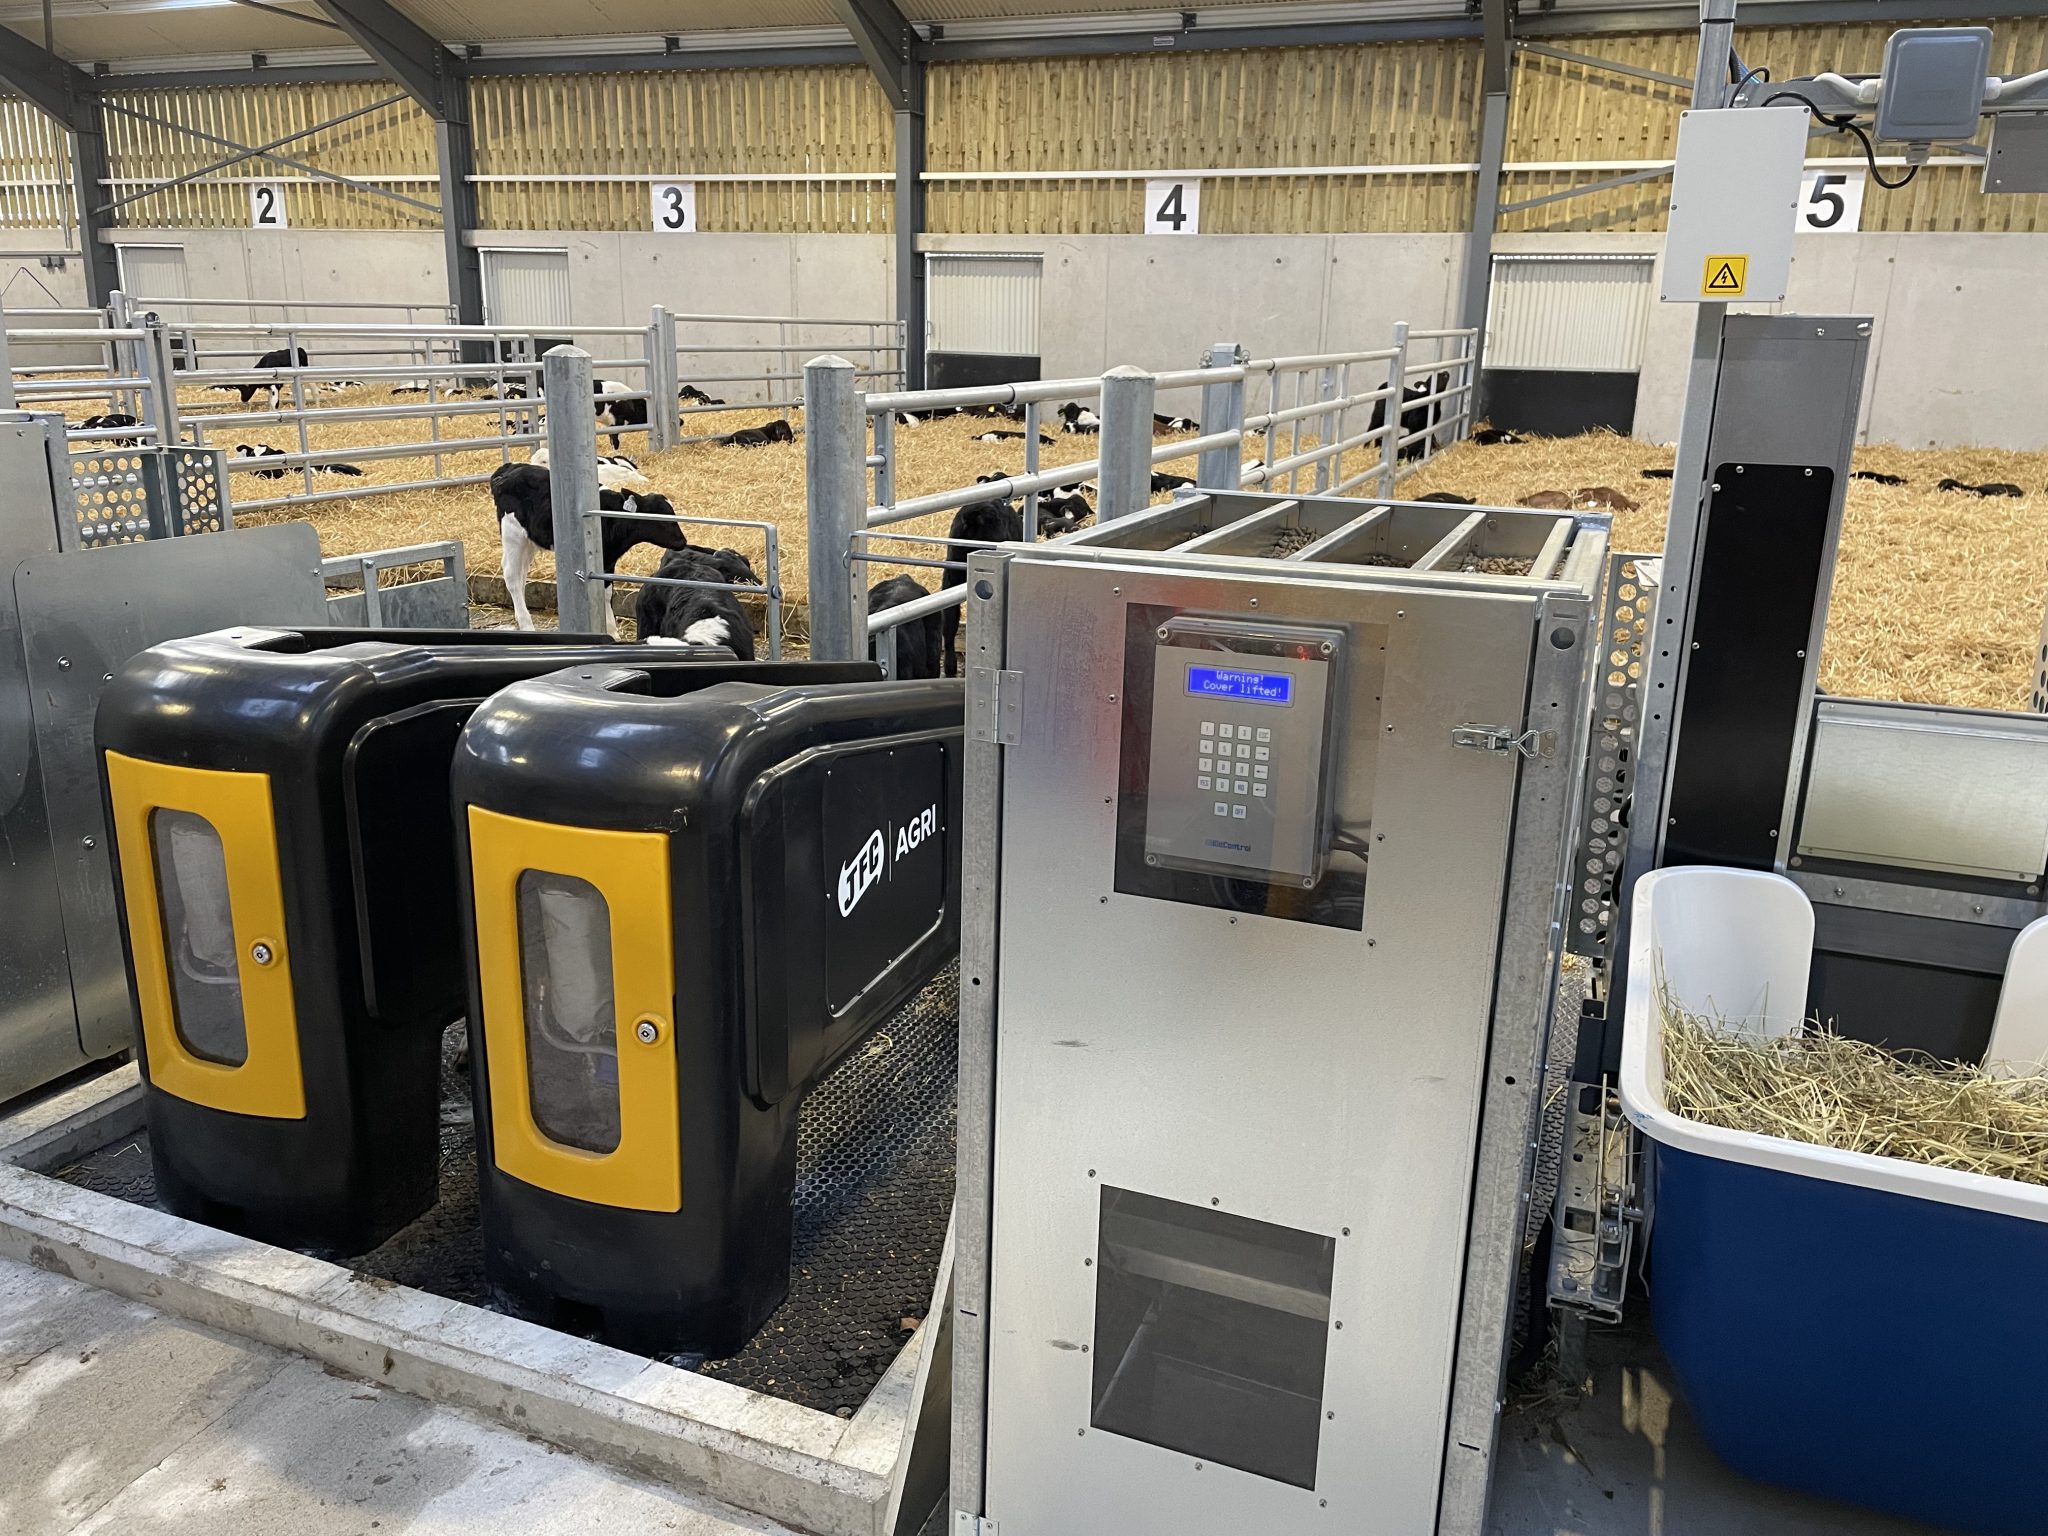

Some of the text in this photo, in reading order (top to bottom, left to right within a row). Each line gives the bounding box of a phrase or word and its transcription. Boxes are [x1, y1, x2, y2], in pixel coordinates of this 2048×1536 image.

[256, 187, 277, 224] 2
[662, 186, 685, 229] 3
[1156, 184, 1187, 231] 4
[1806, 174, 1847, 228] 5
[1203, 680, 1282, 697] Cover lifted!
[1215, 670, 1264, 685] Warning!
[844, 803, 936, 912] JFC AGRI
